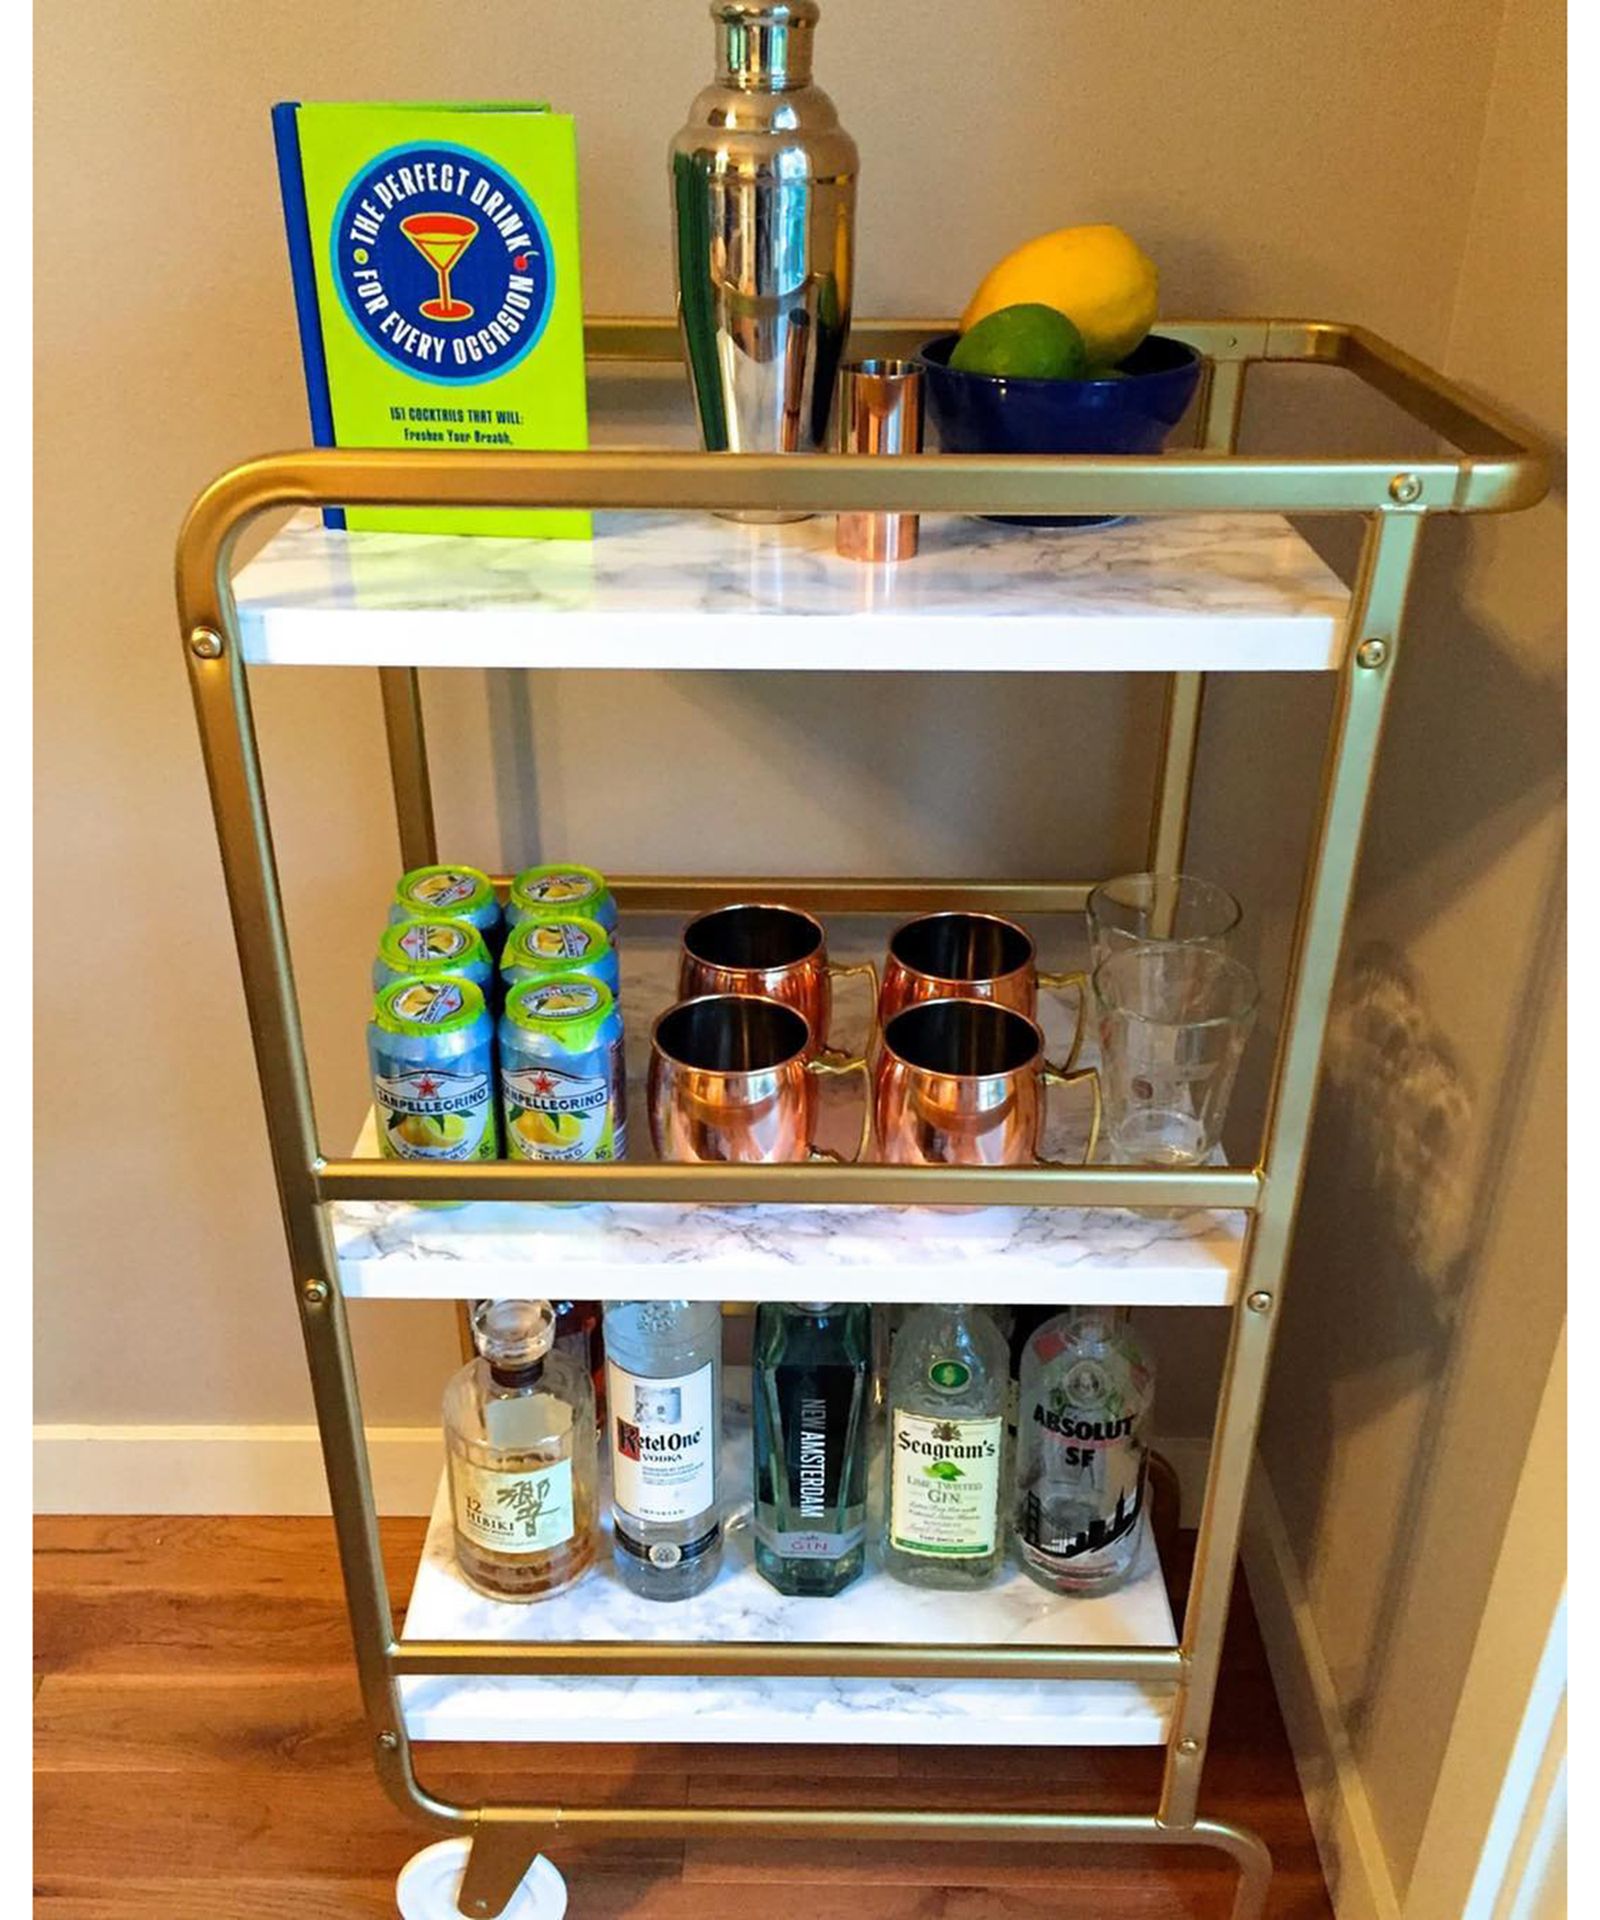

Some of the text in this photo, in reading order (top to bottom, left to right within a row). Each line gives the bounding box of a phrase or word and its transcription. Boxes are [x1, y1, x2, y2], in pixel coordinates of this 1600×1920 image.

[350, 162, 532, 252] THE PERFECT DRINK
[353, 269, 534, 365] FOR EVERY OCCASION
[390, 407, 406, 421] 151
[408, 407, 464, 422] COCKTAILS
[467, 409, 492, 424] THAT
[403, 428, 444, 441] Freshen
[447, 430, 471, 443] Your
[1033, 1403, 1139, 1440] ABSOLUT
[617, 1419, 701, 1453] Ketel One
[898, 1429, 996, 1461] Seagram's
[642, 1453, 683, 1463] VODKA
[801, 1399, 827, 1518] NEW AMSTERDAM
[1065, 1446, 1095, 1468] SF
[466, 1497, 482, 1513] 12
[928, 1489, 960, 1503] GIN
[791, 1542, 828, 1551] GIN
